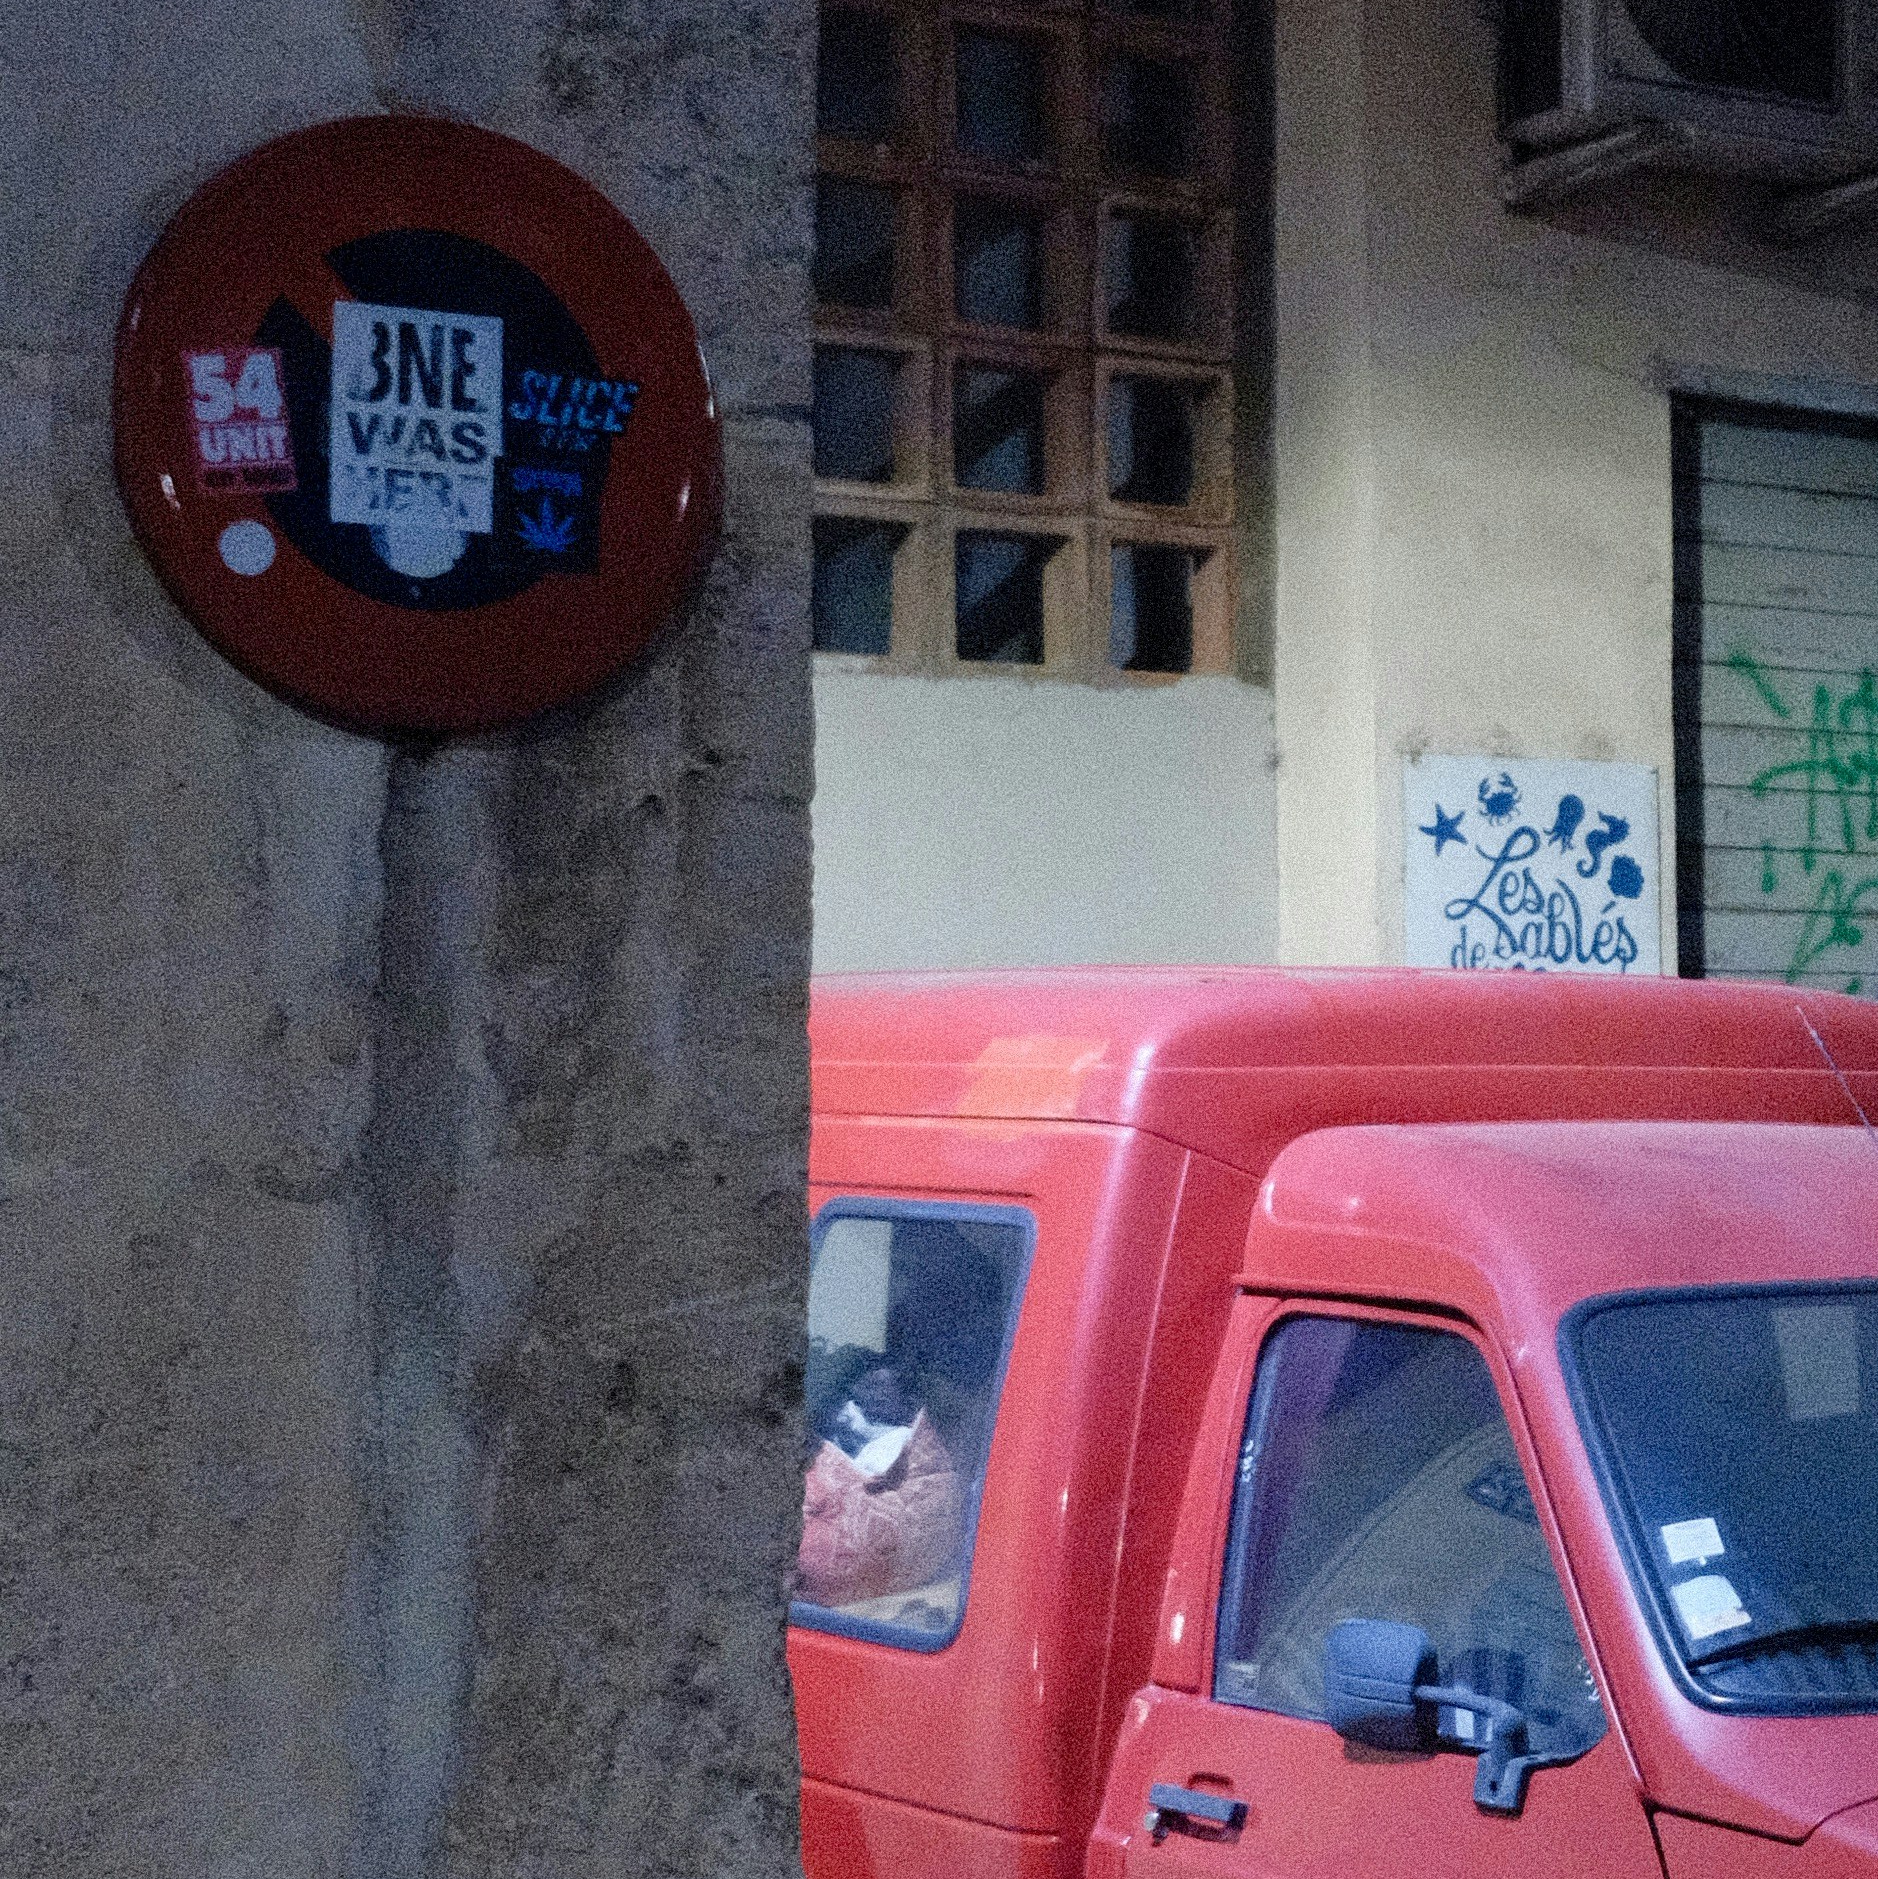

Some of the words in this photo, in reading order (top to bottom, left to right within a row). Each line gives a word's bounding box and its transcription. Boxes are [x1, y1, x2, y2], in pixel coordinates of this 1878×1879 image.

[190, 352, 283, 422] 54
[199, 424, 288, 463] UNIT
[345, 411, 488, 465] WAS
[1444, 825, 1546, 921] Les
[1450, 924, 1487, 970] de
